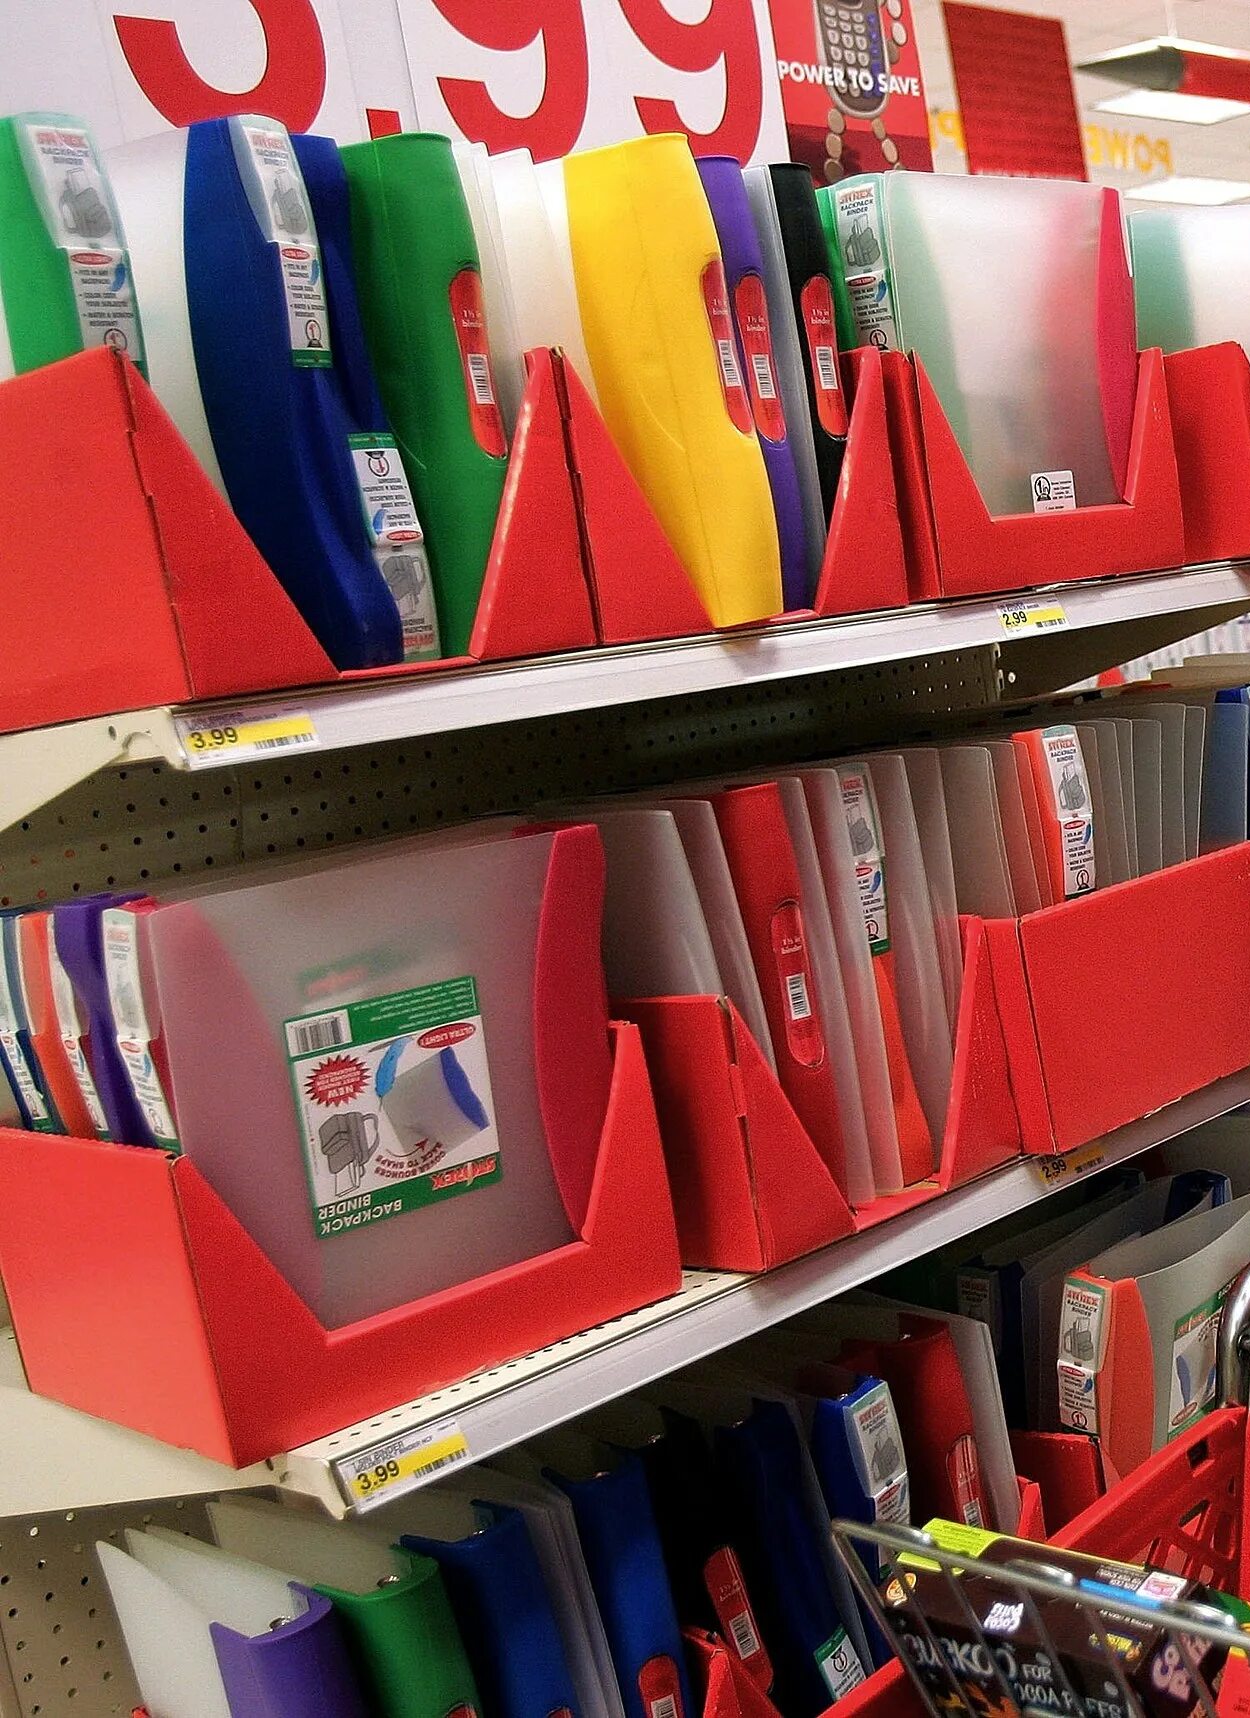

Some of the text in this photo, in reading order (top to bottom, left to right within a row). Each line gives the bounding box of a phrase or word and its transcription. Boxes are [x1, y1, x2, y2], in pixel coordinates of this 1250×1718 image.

[777, 59, 921, 97] POWER TO SAVE
[840, 199, 874, 212] BACKPACK
[846, 207, 869, 216] BINDER
[1002, 610, 1028, 626] 2.99
[190, 726, 239, 749] 3.99
[327, 1084, 355, 1098] NEW
[374, 1151, 446, 1180] COVER BOUNCES
[375, 1154, 405, 1169] SHAPE
[407, 1159, 419, 1168] TO
[1041, 1159, 1068, 1179] 2.99
[317, 1193, 372, 1220] BINDER
[321, 1199, 403, 1235] BACKPACK
[1066, 1299, 1098, 1314] BACKPACK
[1071, 1306, 1093, 1318] BINDER
[357, 1459, 400, 1490] 3.99
[1022, 1663, 1052, 1682] FOR
